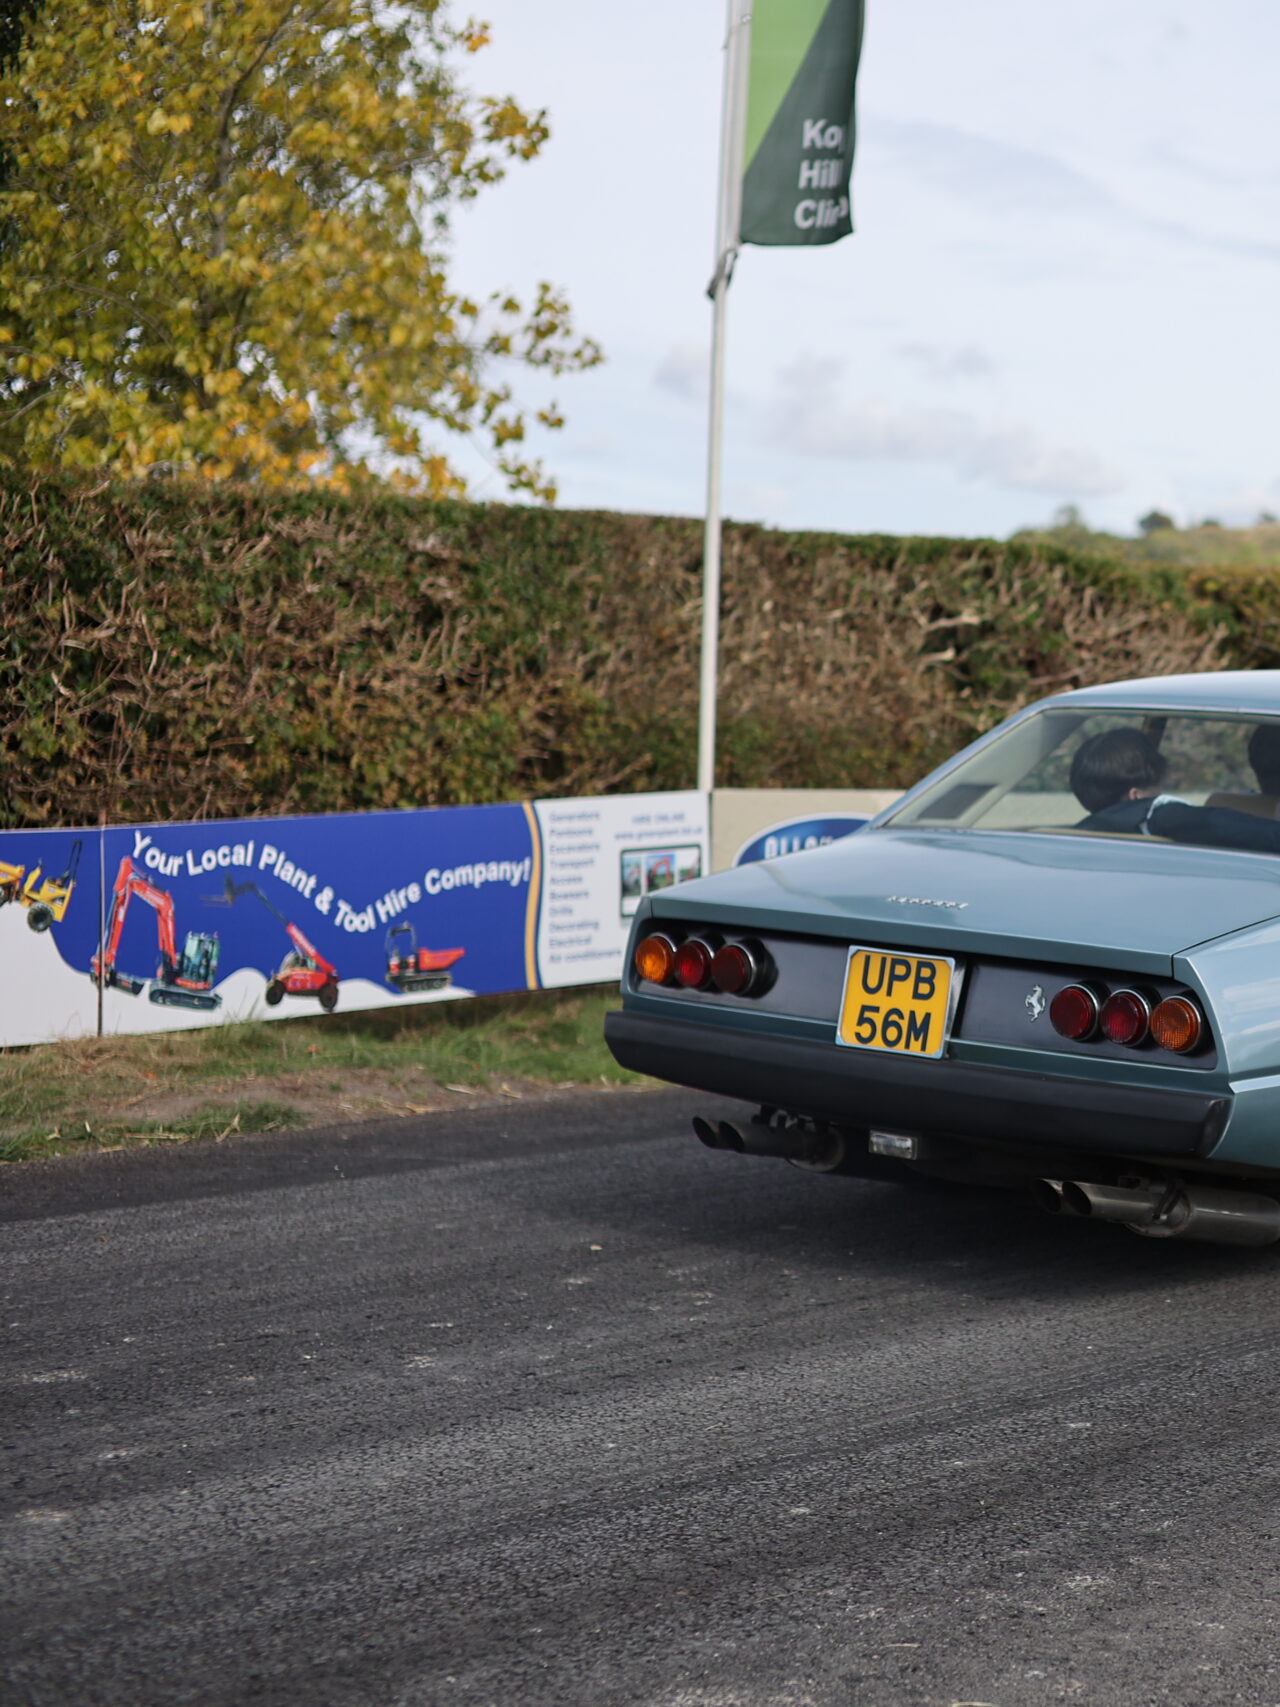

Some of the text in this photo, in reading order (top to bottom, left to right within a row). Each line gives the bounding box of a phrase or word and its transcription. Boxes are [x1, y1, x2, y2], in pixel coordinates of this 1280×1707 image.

[803, 119, 845, 153] Ko
[133, 829, 532, 933] Your Local Plant & Tool Hire Company!
[861, 954, 937, 1001] UPB
[854, 1004, 932, 1052] 56M
